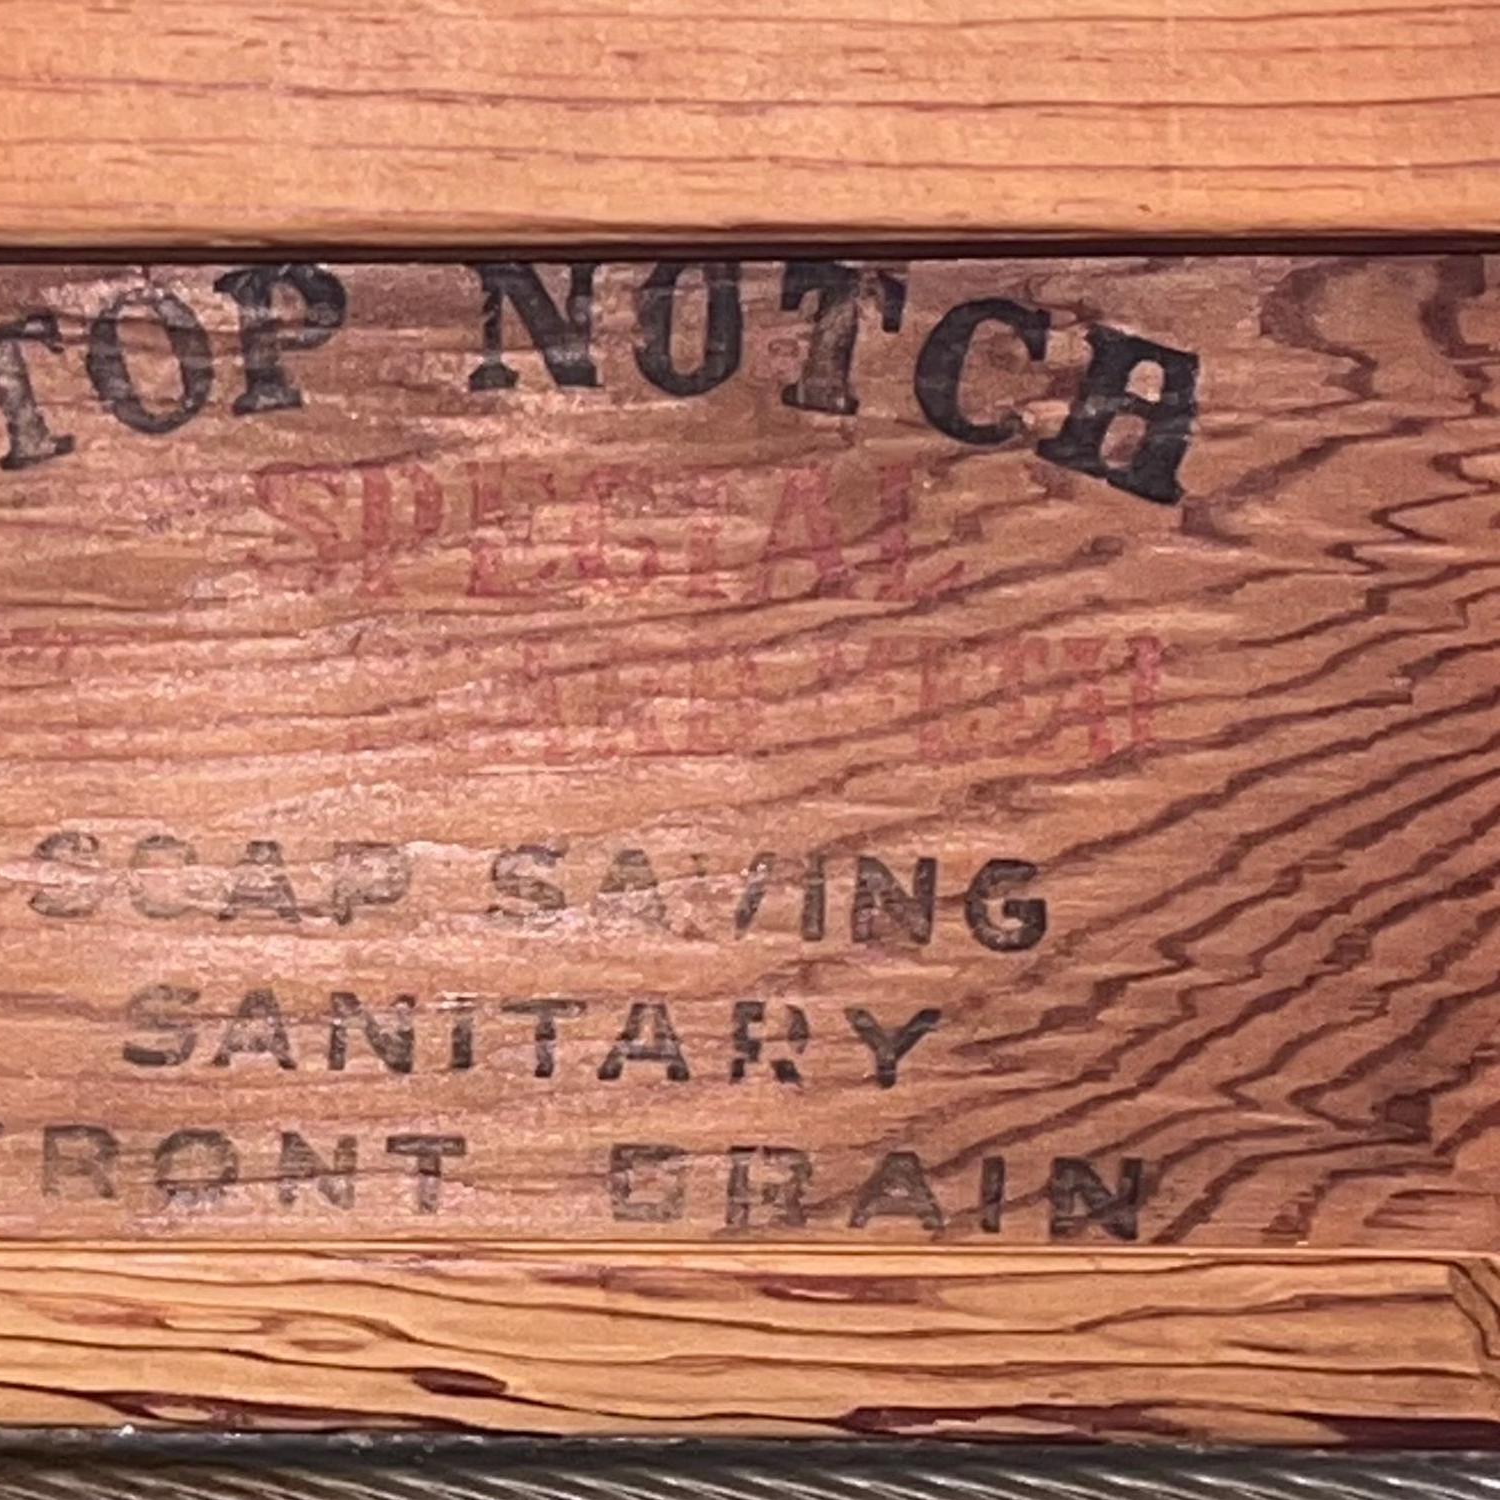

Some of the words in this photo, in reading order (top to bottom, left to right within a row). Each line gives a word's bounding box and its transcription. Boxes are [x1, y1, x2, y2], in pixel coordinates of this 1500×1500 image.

[467, 262, 1200, 507] NOTCH
[27, 830, 414, 926] SOAP
[486, 842, 1050, 953] SAVING
[122, 984, 942, 1090] SANITARY
